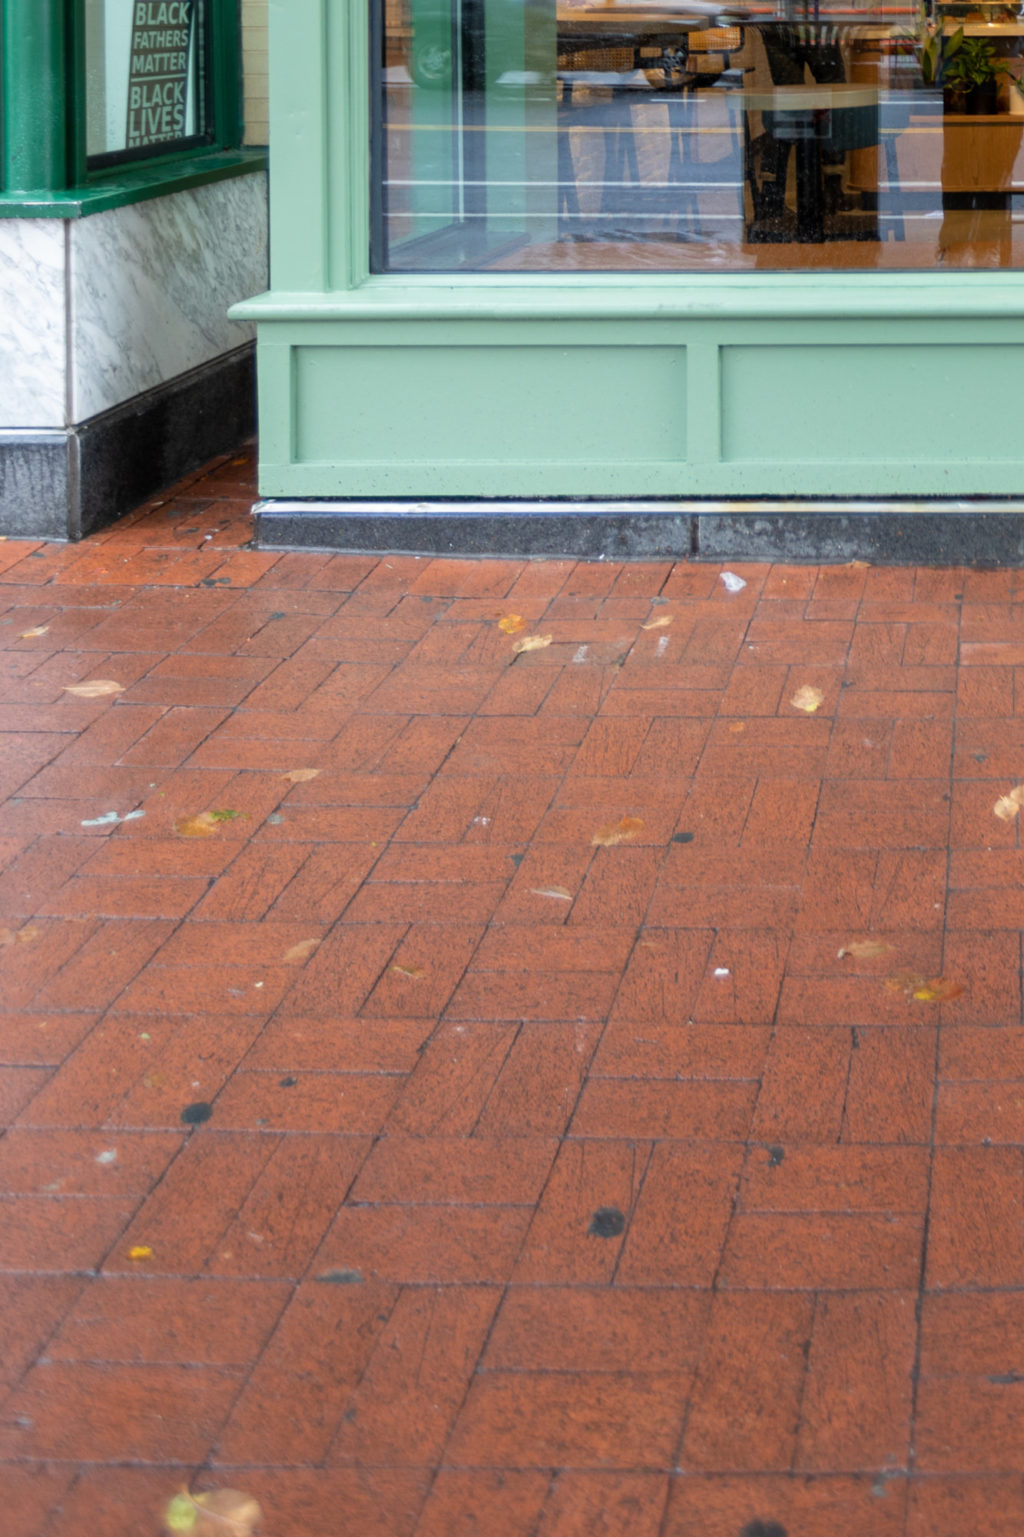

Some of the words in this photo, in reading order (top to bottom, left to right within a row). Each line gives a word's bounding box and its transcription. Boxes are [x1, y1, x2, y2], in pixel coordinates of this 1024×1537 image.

[135, 2, 190, 25] BLACK
[134, 29, 189, 49] FATHERS
[132, 52, 186, 74] MATTER
[130, 82, 184, 109] BLACK
[129, 105, 184, 137] LIVES
